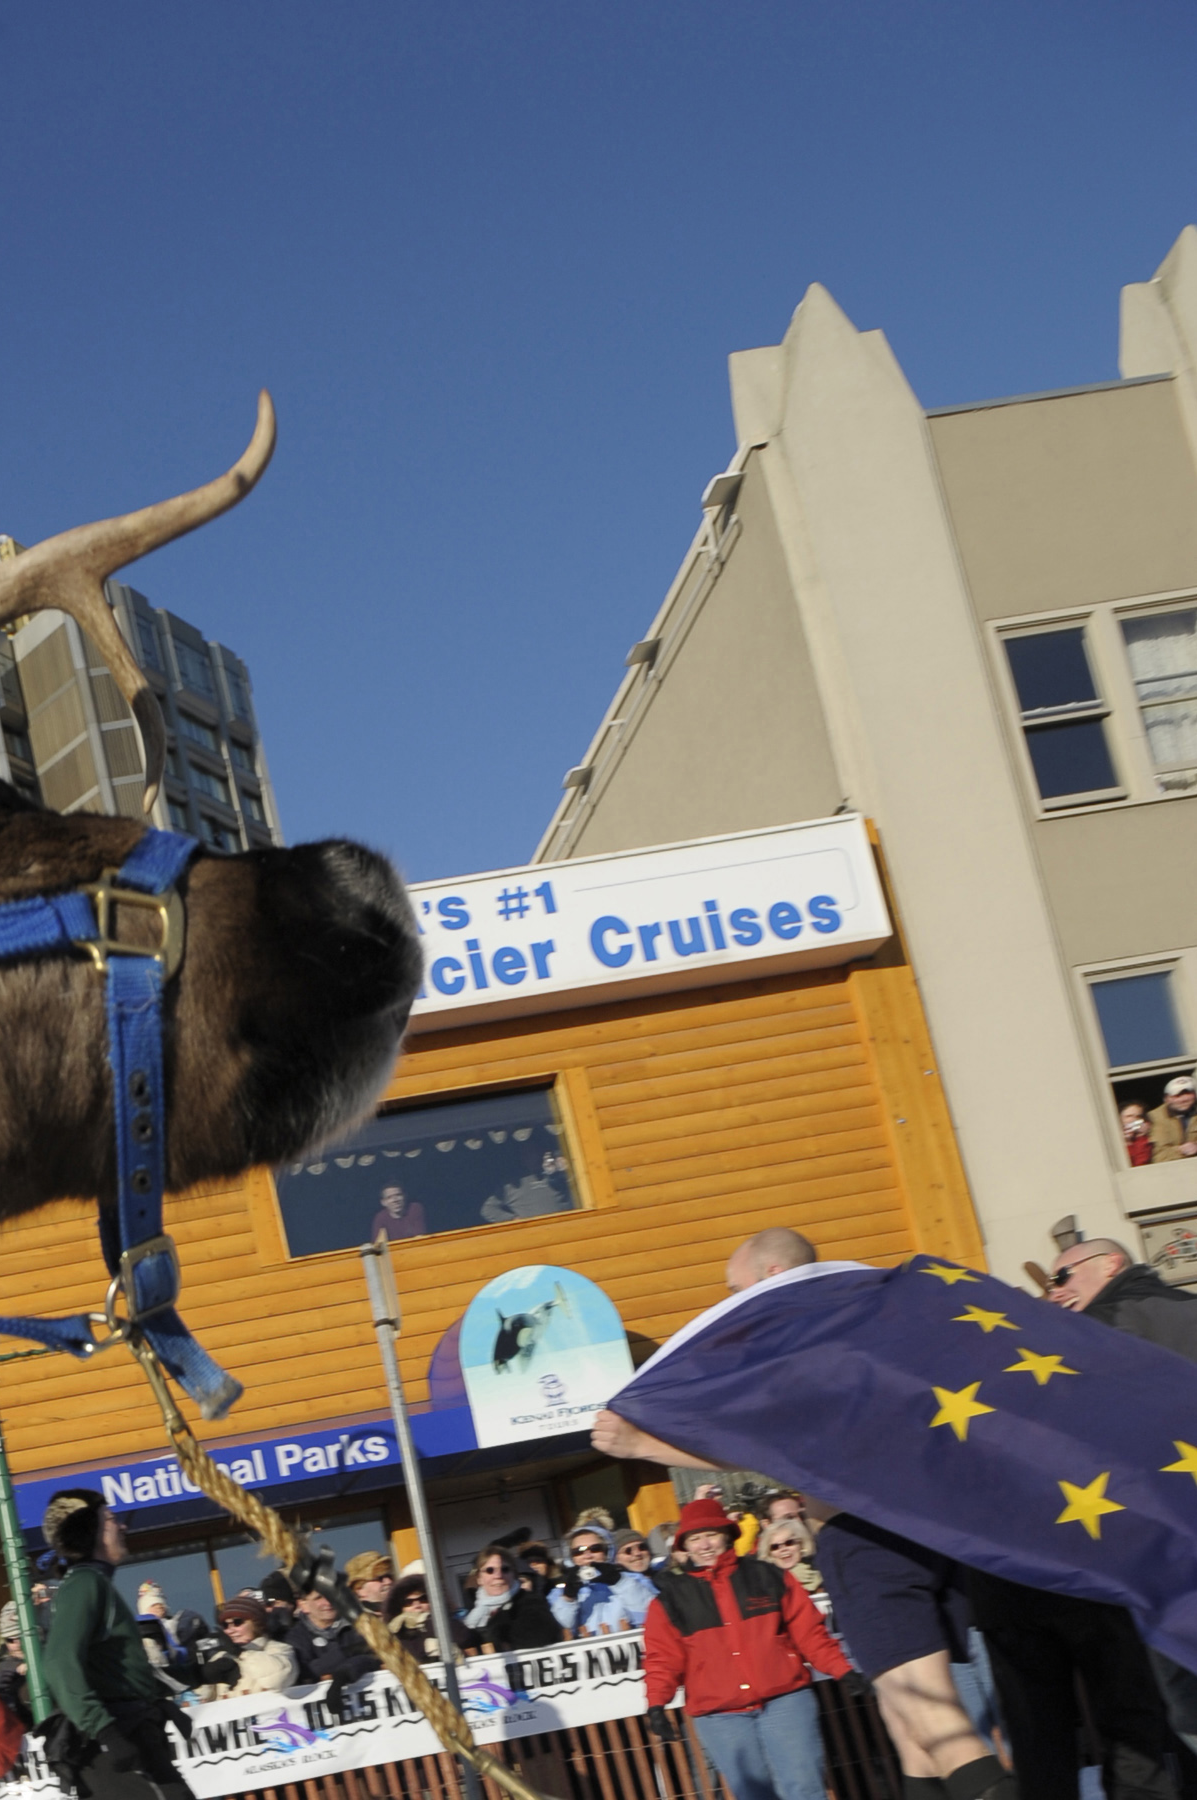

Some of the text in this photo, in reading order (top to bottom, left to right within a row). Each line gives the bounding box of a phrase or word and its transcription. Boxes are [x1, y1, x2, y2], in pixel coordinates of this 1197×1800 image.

[496, 880, 558, 921] #1
[415, 894, 842, 1000] cier Cruises
[274, 1435, 390, 1477] Parks
